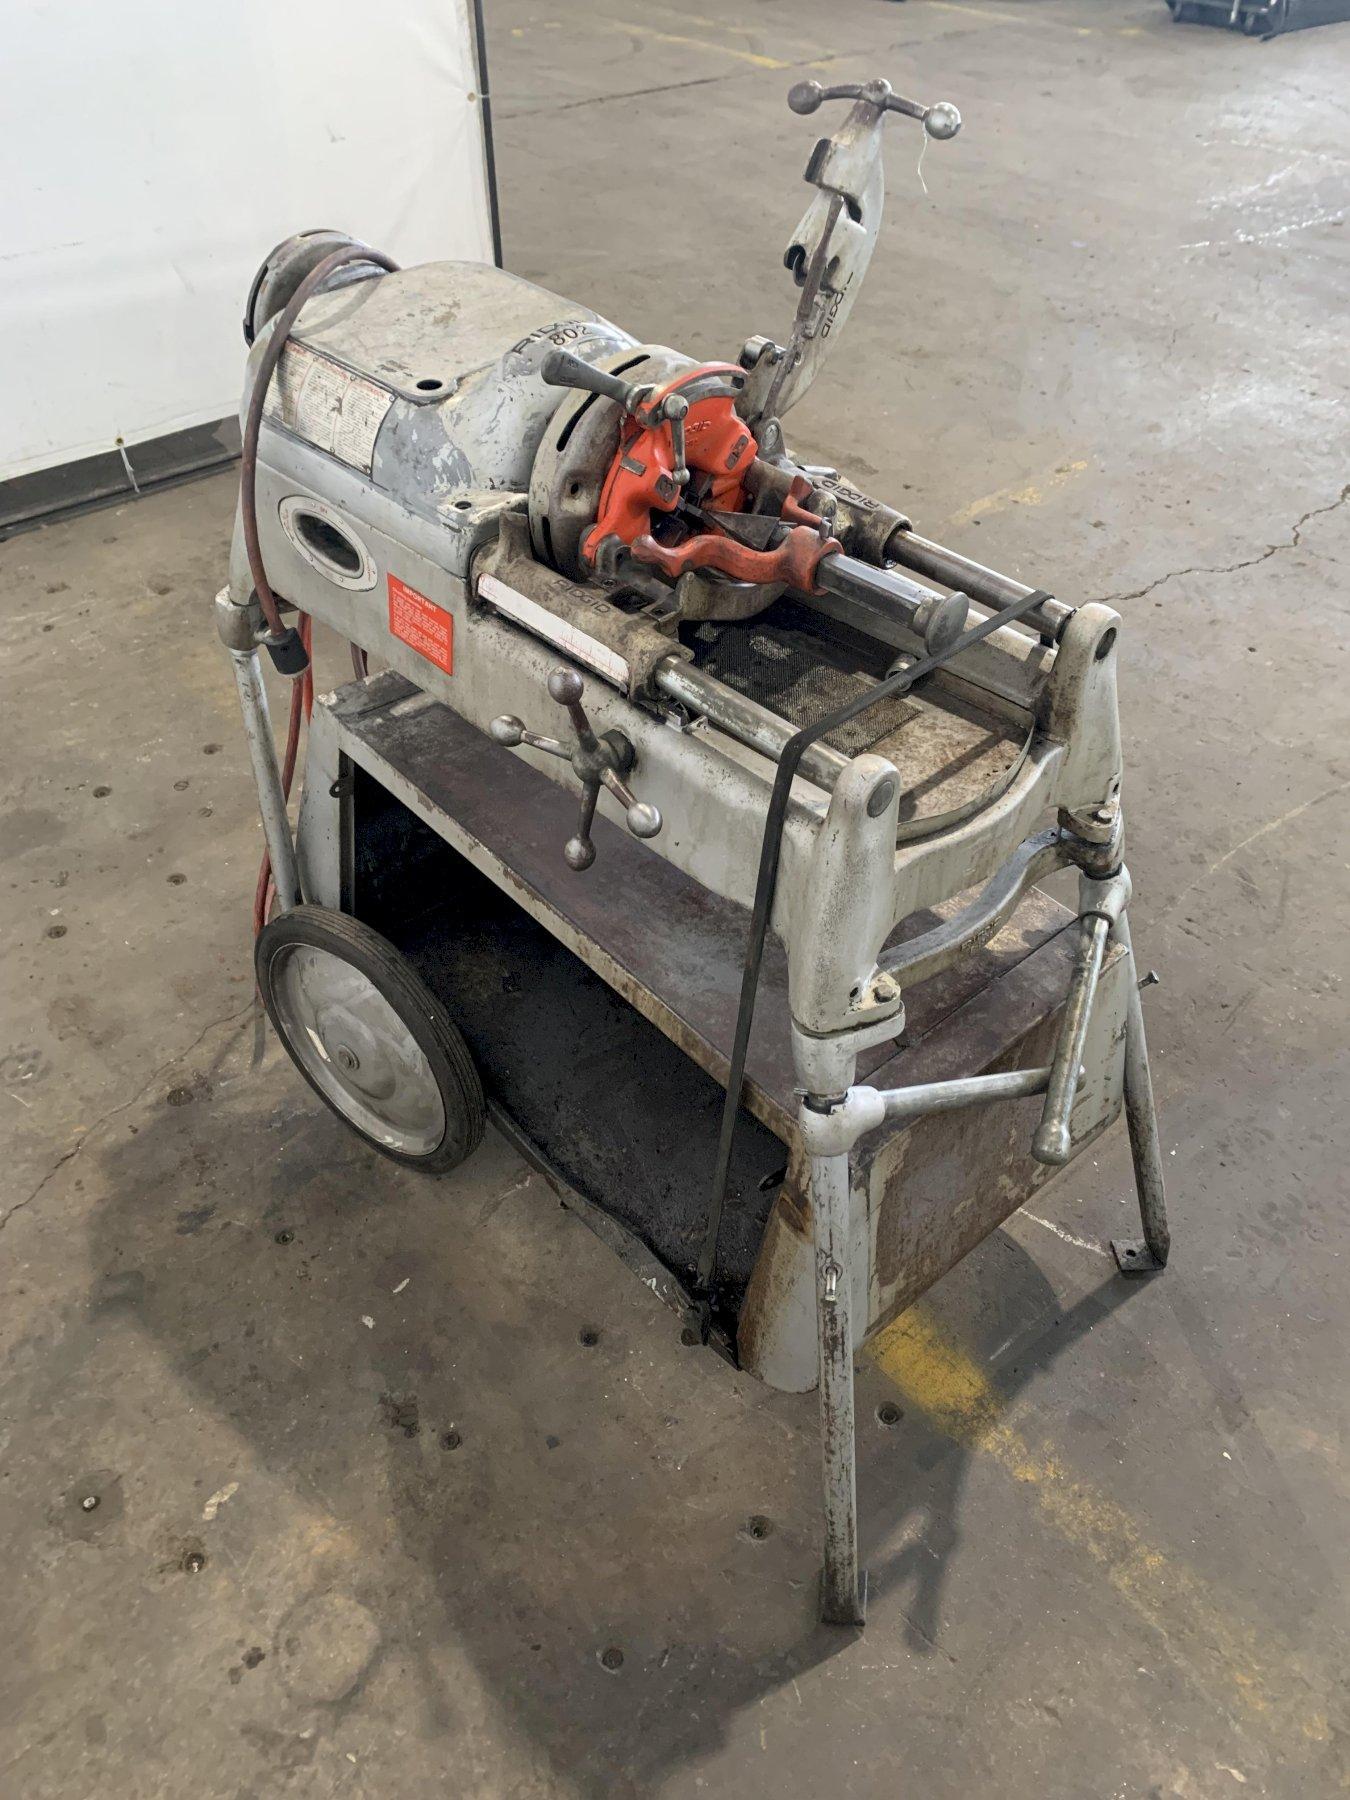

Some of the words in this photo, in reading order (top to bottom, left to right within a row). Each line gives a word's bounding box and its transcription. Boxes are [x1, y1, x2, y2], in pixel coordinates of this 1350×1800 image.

[549, 325, 593, 346] 802
[821, 480, 881, 510] RIDGID
[552, 579, 611, 613] RIDGID
